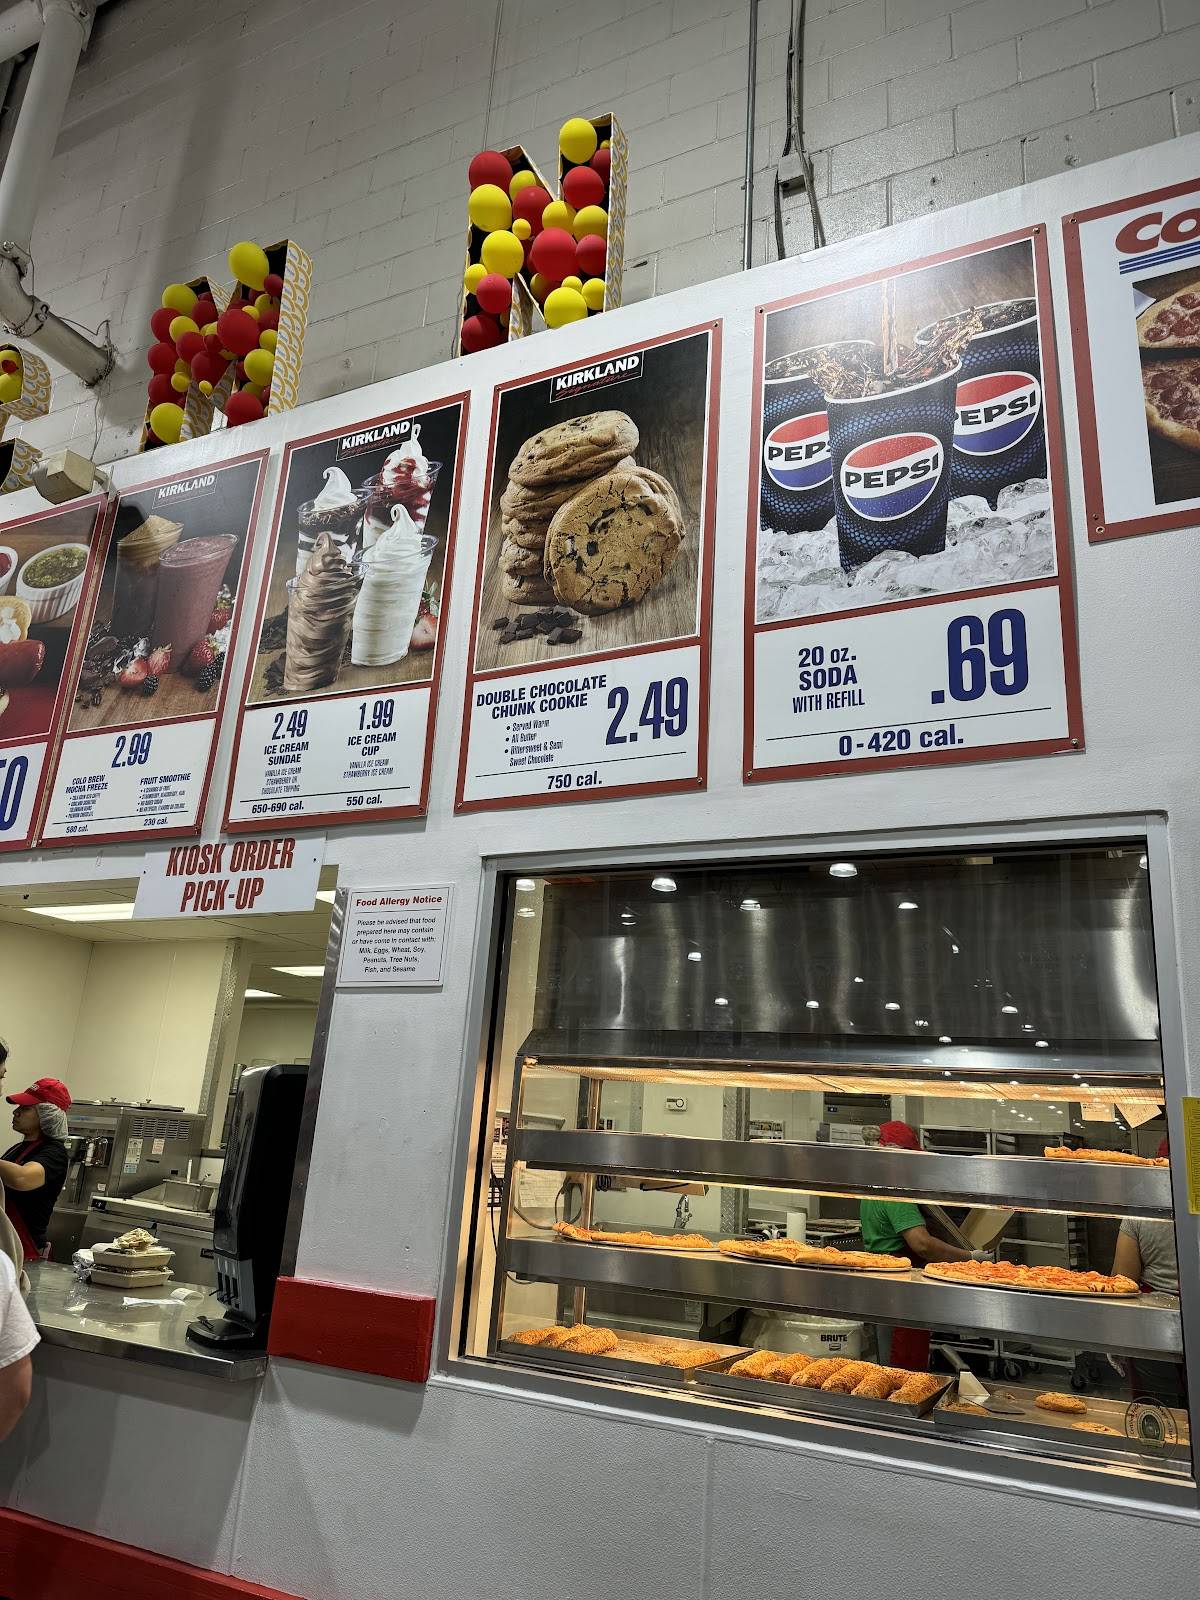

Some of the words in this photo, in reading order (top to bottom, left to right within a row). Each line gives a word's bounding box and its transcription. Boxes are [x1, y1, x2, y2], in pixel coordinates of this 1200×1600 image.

[556, 355, 639, 391] KIRKLAND
[342, 421, 410, 450] KIRKLAND
[768, 440, 831, 462] PEP
[845, 452, 939, 489] PEPSI
[158, 475, 215, 499] KIRKLAND
[798, 645, 825, 668] 20
[830, 647, 857, 664] oz.
[931, 608, 1029, 705] .69
[799, 664, 858, 691] SODA
[476, 686, 526, 707] DOUBLE
[529, 674, 607, 698] CHOCOLATE
[792, 694, 823, 714] WITH
[826, 689, 865, 711] REFILL
[359, 699, 395, 731] 1.99
[492, 704, 538, 720] CHUNK
[540, 693, 588, 713] COOKIE
[605, 676, 689, 746] 2.49
[272, 709, 308, 741] 2.49
[512, 720, 532, 732] Served
[533, 719, 550, 729] Warm
[919, 723, 964, 748] cal.
[111, 731, 153, 769] 2.99
[264, 745, 277, 755] ICE
[279, 742, 309, 754] CREAM
[348, 736, 362, 746] ICE
[364, 732, 396, 745] CREAM
[510, 743, 542, 755] Bittersweet
[268, 753, 301, 766] SUNDAE
[361, 745, 380, 757] CUP
[509, 756, 527, 767] Sweet
[528, 753, 554, 765] Chocolate
[65, 785, 86, 794] MOCHA
[86, 782, 109, 792] FREEZE
[72, 776, 87, 785] COLD
[87, 775, 106, 783] BREW
[140, 776, 158, 786] FRUIT
[159, 772, 192, 784] SMOOTHIE
[547, 773, 572, 790] 750
[576, 771, 602, 787] cal.
[0, 755, 29, 831] 0
[346, 795, 364, 806] 550
[366, 794, 383, 805] cal.
[251, 801, 287, 814] 650-690
[289, 800, 304, 812] cal.
[143, 818, 156, 826] 230
[157, 816, 169, 825] cal.
[166, 842, 227, 877] KIOSK
[229, 837, 296, 873] ORDER
[180, 877, 264, 912] PICK-UP
[356, 898, 378, 907] Food
[379, 896, 410, 906] Allergy
[412, 895, 442, 904] Notice
[356, 928, 383, 936] prepared
[383, 927, 397, 935] here
[820, 1334, 848, 1342] BRUTE
